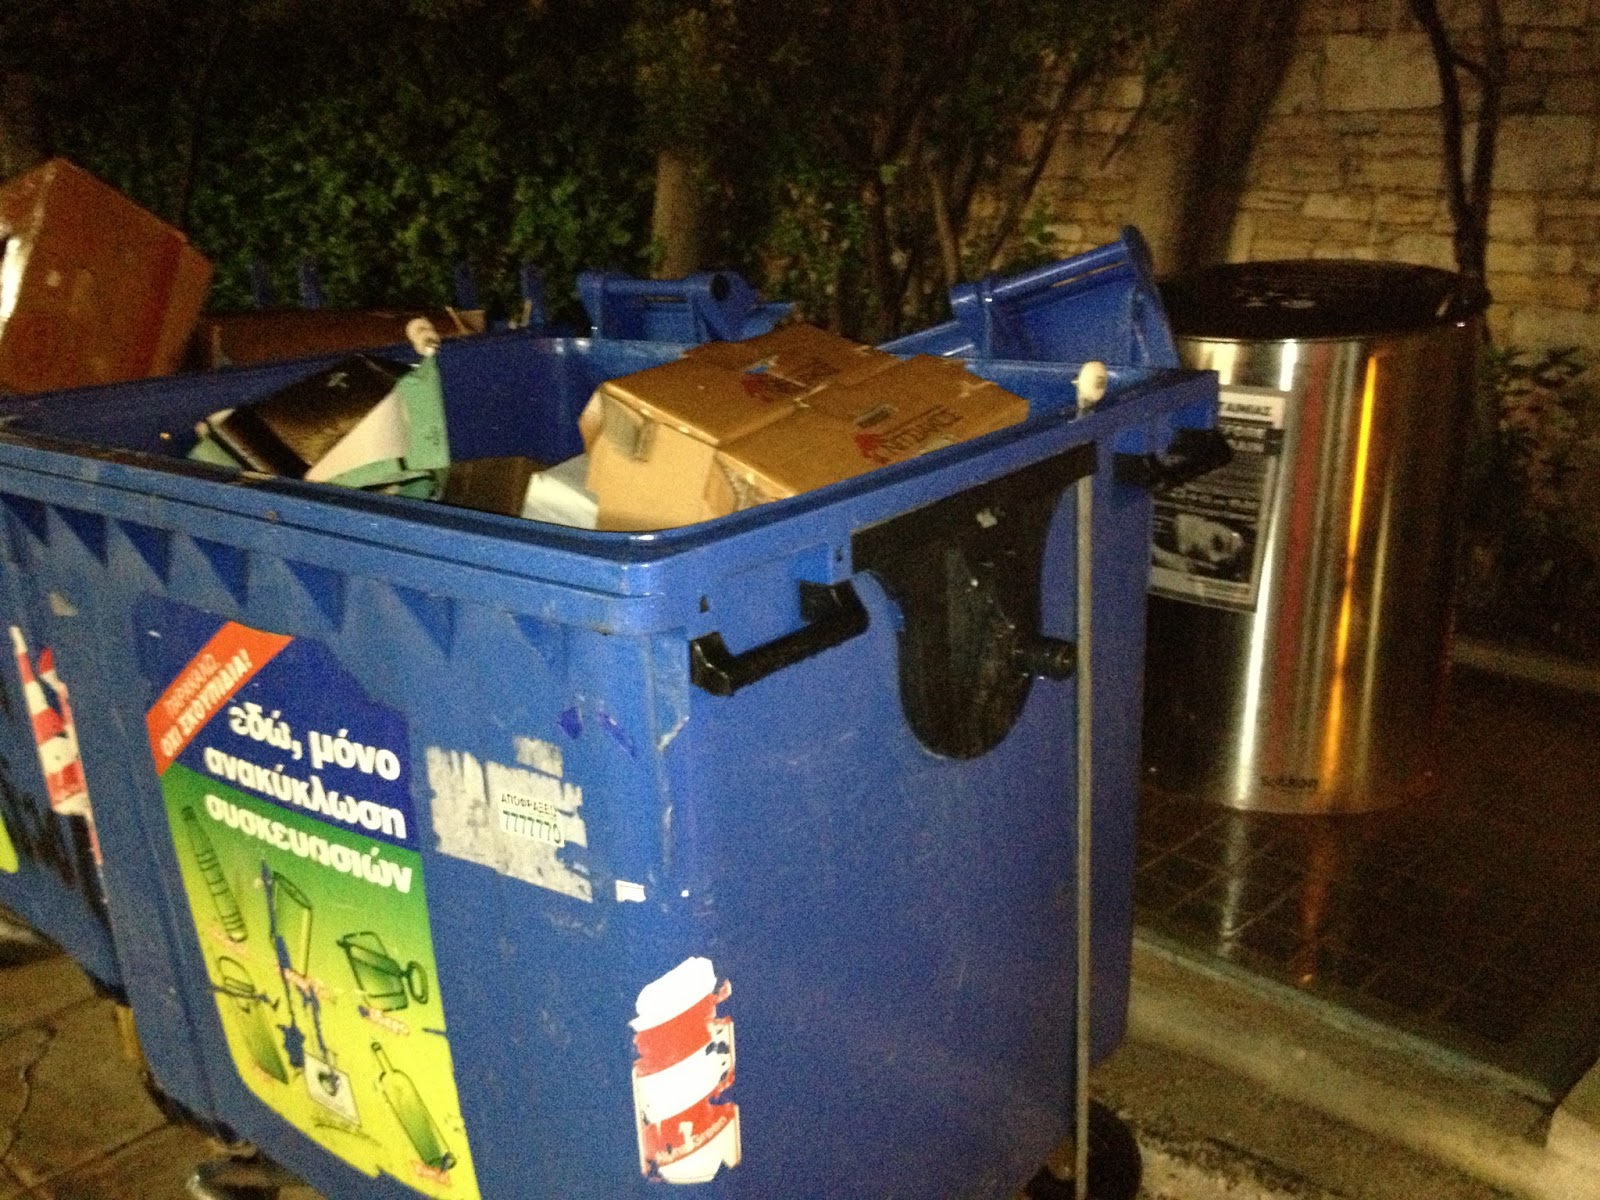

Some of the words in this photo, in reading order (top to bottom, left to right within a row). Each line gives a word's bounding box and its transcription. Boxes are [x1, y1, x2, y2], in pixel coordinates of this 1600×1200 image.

[228, 701, 303, 760] εδώ,
[309, 728, 401, 780] μόνο
[204, 747, 407, 839] ανακύκλωση
[502, 809, 562, 844] 7777770
[204, 794, 412, 893] συσκευασιών
